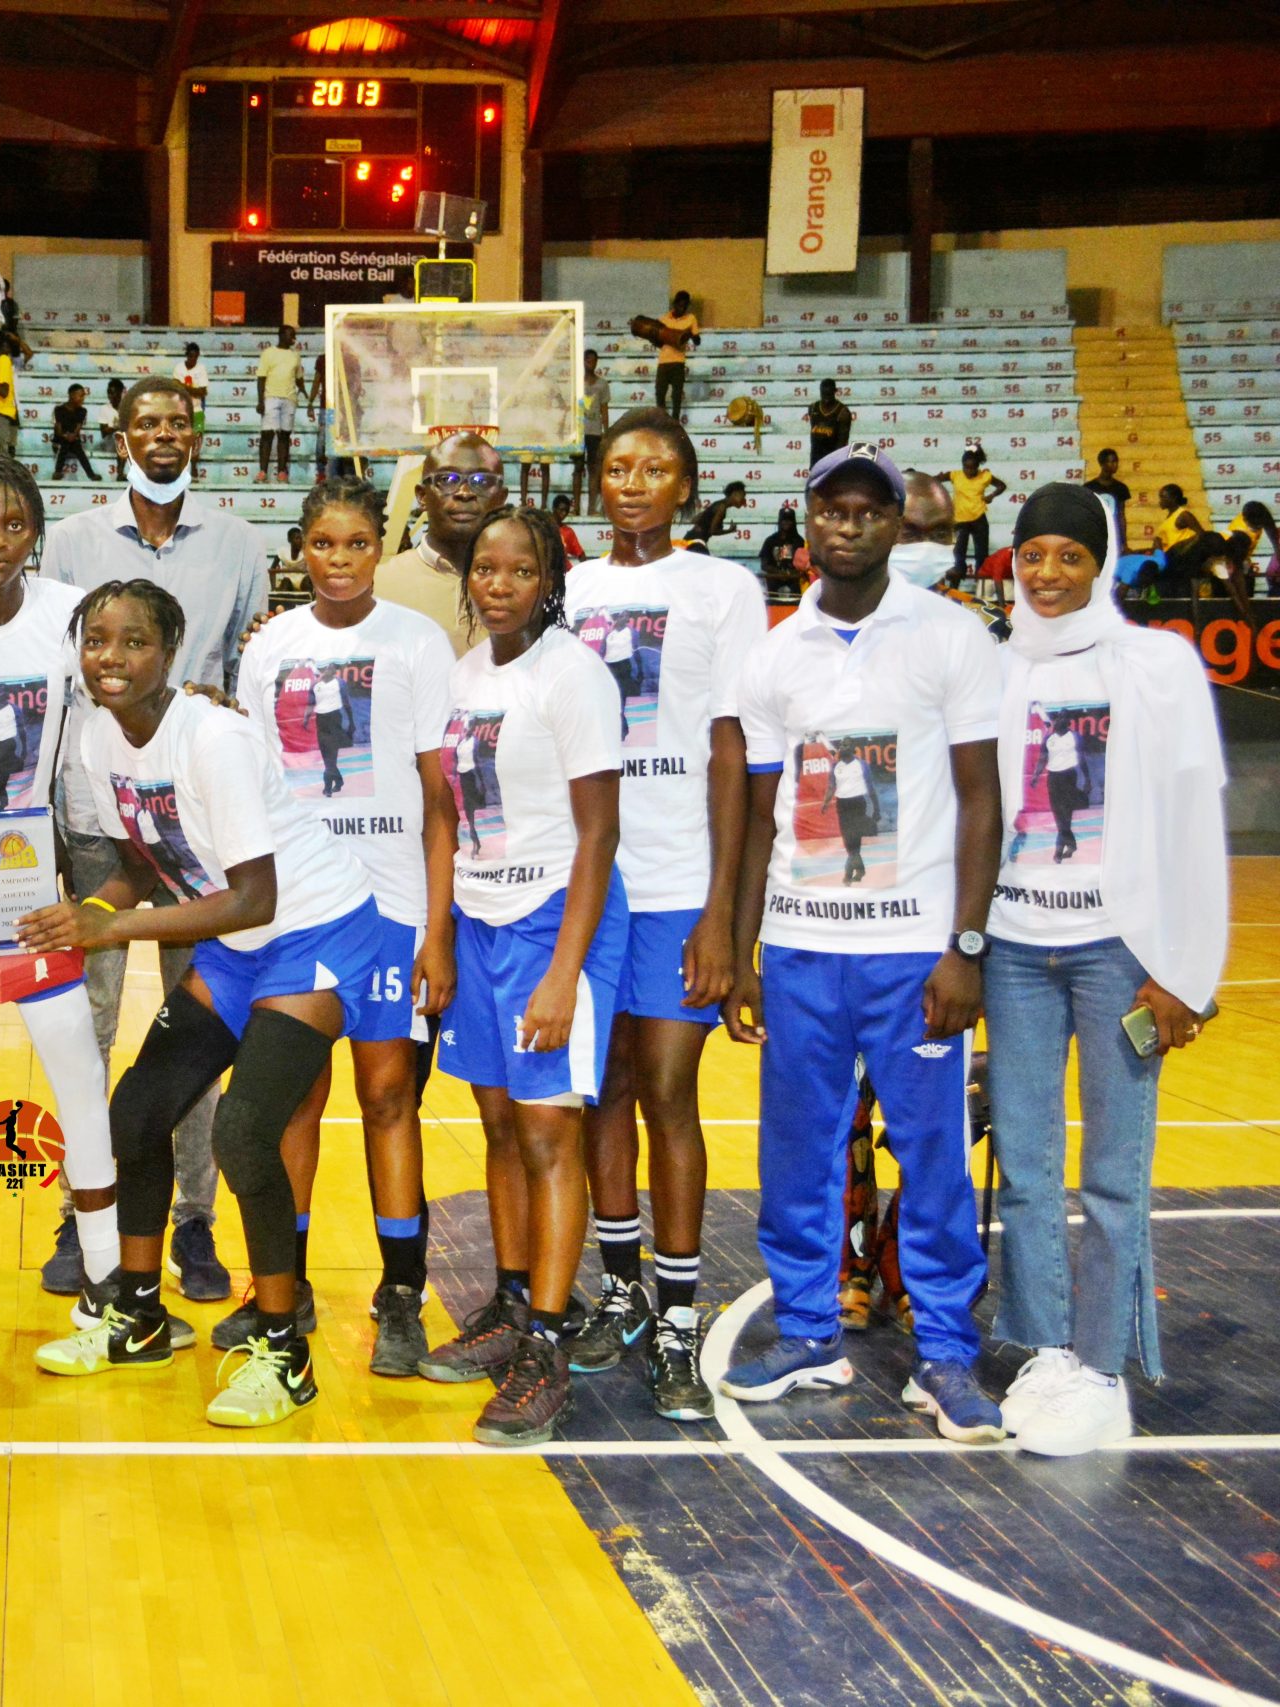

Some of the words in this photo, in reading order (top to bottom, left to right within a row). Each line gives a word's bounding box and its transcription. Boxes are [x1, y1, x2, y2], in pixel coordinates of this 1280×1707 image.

[312, 80, 344, 106] 20
[357, 80, 380, 106] 13
[799, 149, 833, 255] Orange
[258, 249, 337, 263] Fédération
[291, 267, 309, 280] de
[313, 268, 365, 281] Basket
[368, 268, 394, 281] Ball
[712, 367, 727, 378] 50
[756, 365, 771, 375] 51
[39, 387, 53, 397] 32
[233, 387, 246, 397] 37
[752, 386, 766, 395] 50
[881, 387, 896, 398] 53
[922, 387, 937, 398] 54
[962, 386, 977, 397] 55
[1005, 384, 1020, 396] 56
[1046, 384, 1060, 394] 57
[630, 392, 644, 401] 47
[25, 409, 38, 420] 30
[927, 409, 943, 419] 52
[971, 409, 987, 419] 53
[1008, 409, 1024, 419] 54
[1200, 406, 1215, 416] 56
[1244, 406, 1260, 418] 57
[227, 413, 241, 422] 35
[882, 411, 897, 423] 51
[923, 437, 939, 448] 51
[1010, 437, 1027, 448] 53
[1057, 437, 1074, 447] 54
[1204, 433, 1222, 444] 55
[1254, 432, 1271, 443] 56
[702, 439, 717, 448] 46
[786, 440, 801, 450] 48
[234, 467, 249, 476] 33
[745, 470, 762, 480] 45
[1020, 470, 1035, 480] 51
[1066, 469, 1083, 479] 52
[1217, 464, 1235, 475] 53
[699, 470, 716, 481] 44
[51, 495, 65, 505] 27
[92, 494, 107, 505] 28
[261, 498, 276, 508] 32
[1224, 495, 1240, 505] 51
[578, 626, 603, 642] FIBA
[284, 678, 311, 693] FIBA
[651, 757, 687, 776] FALL
[803, 759, 830, 776] FIBA
[370, 816, 404, 835] FALL
[768, 894, 801, 916] PAPE
[806, 899, 876, 920] ALIOUNE
[881, 898, 920, 918] FALL
[368, 966, 403, 1002] 15
